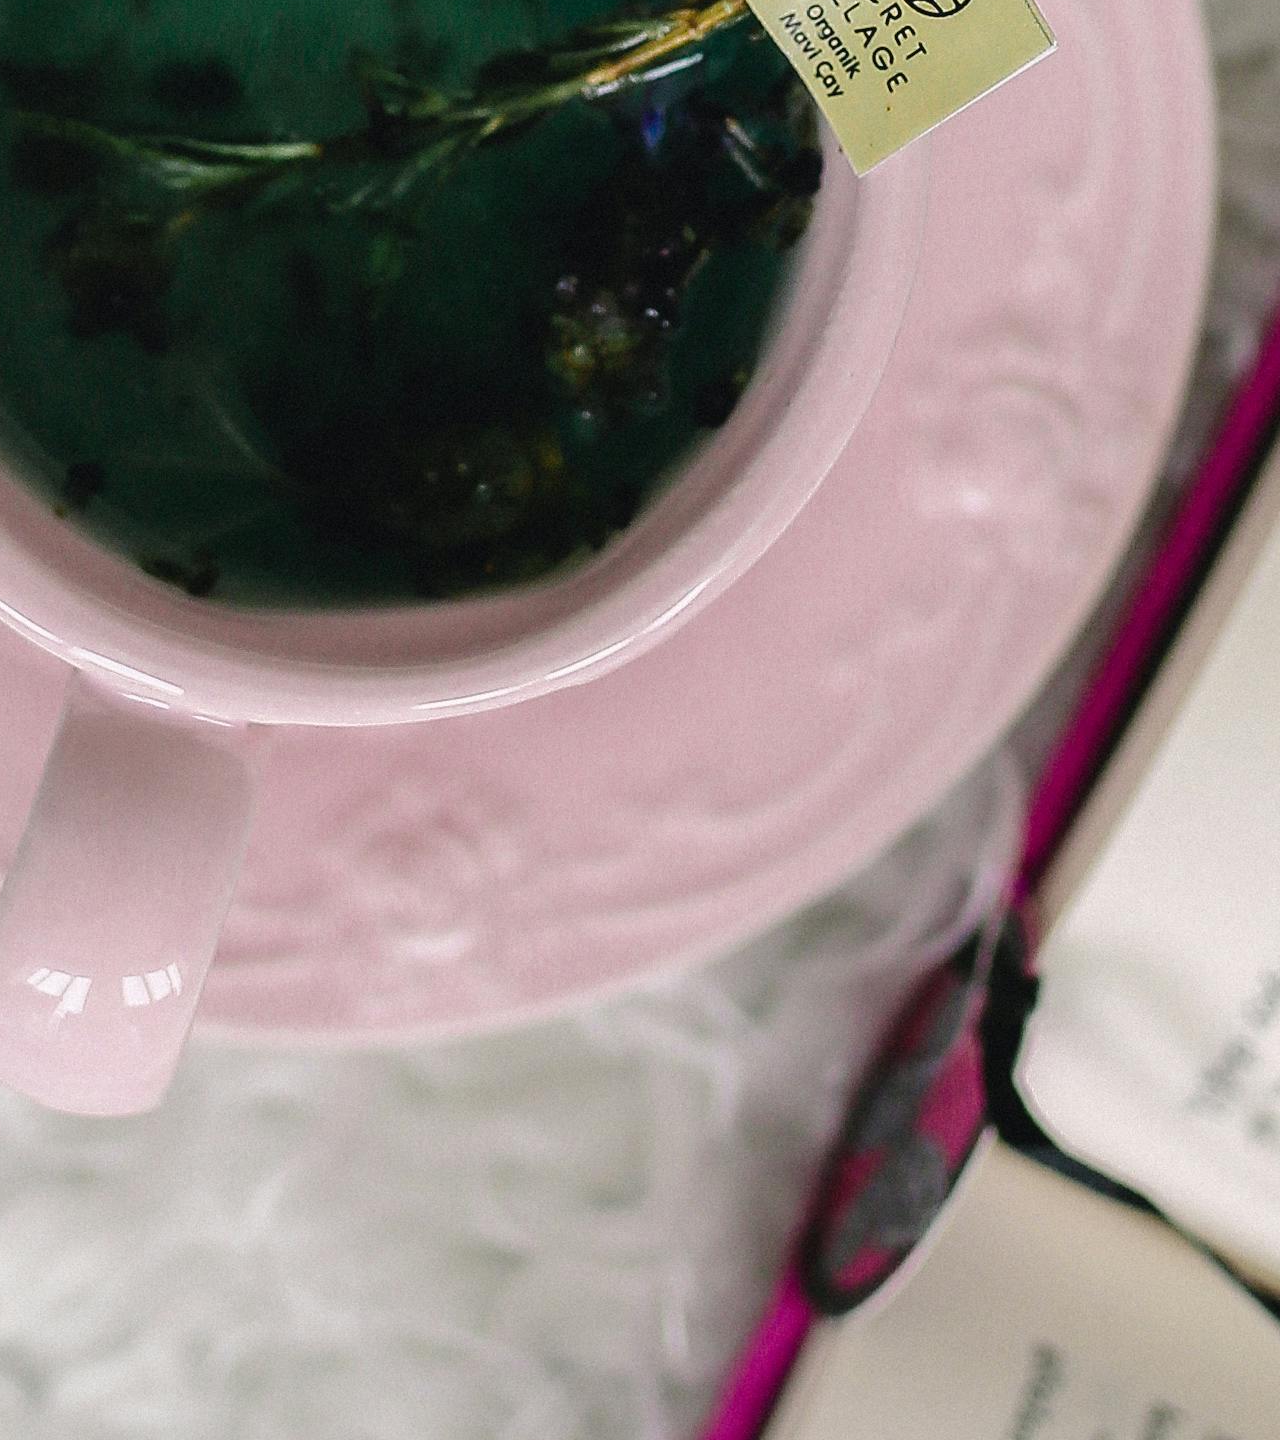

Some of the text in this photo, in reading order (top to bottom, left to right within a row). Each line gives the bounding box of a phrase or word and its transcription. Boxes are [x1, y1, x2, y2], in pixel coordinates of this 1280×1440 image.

[779, 13, 845, 99] Mavi Çay
[805, 4, 862, 80] Organik
